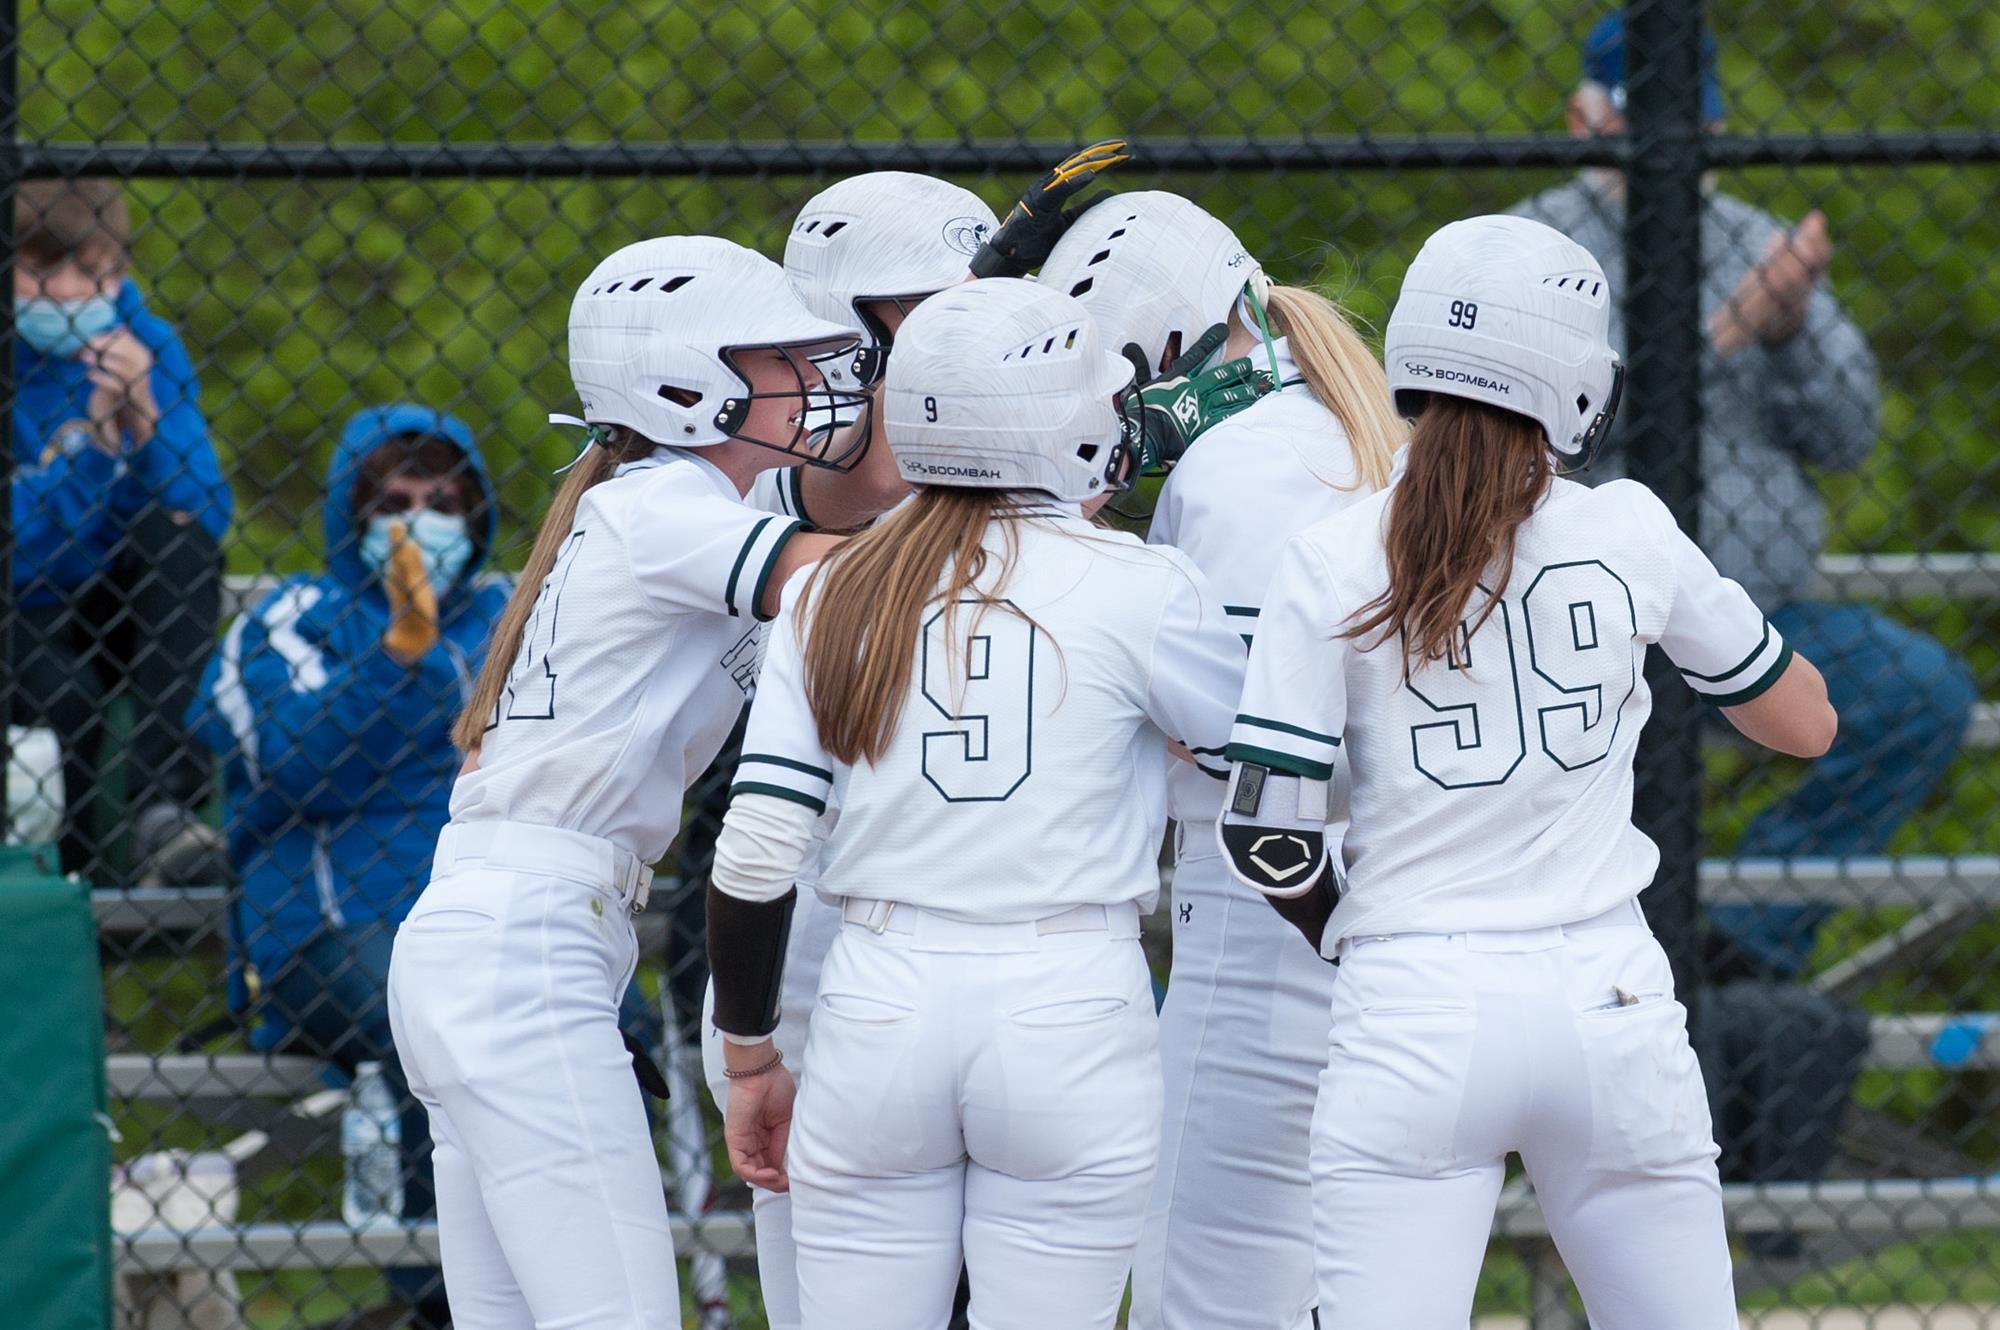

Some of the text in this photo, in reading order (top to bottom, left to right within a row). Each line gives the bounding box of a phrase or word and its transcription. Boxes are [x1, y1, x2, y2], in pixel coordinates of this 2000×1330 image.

[1448, 300, 1478, 330] 99
[1435, 369, 1510, 395] BOOMBAH
[925, 396, 938, 423] 9
[928, 465, 1002, 479] BOOMBAH
[1400, 559, 1637, 790] 99
[921, 599, 1035, 803] 9
